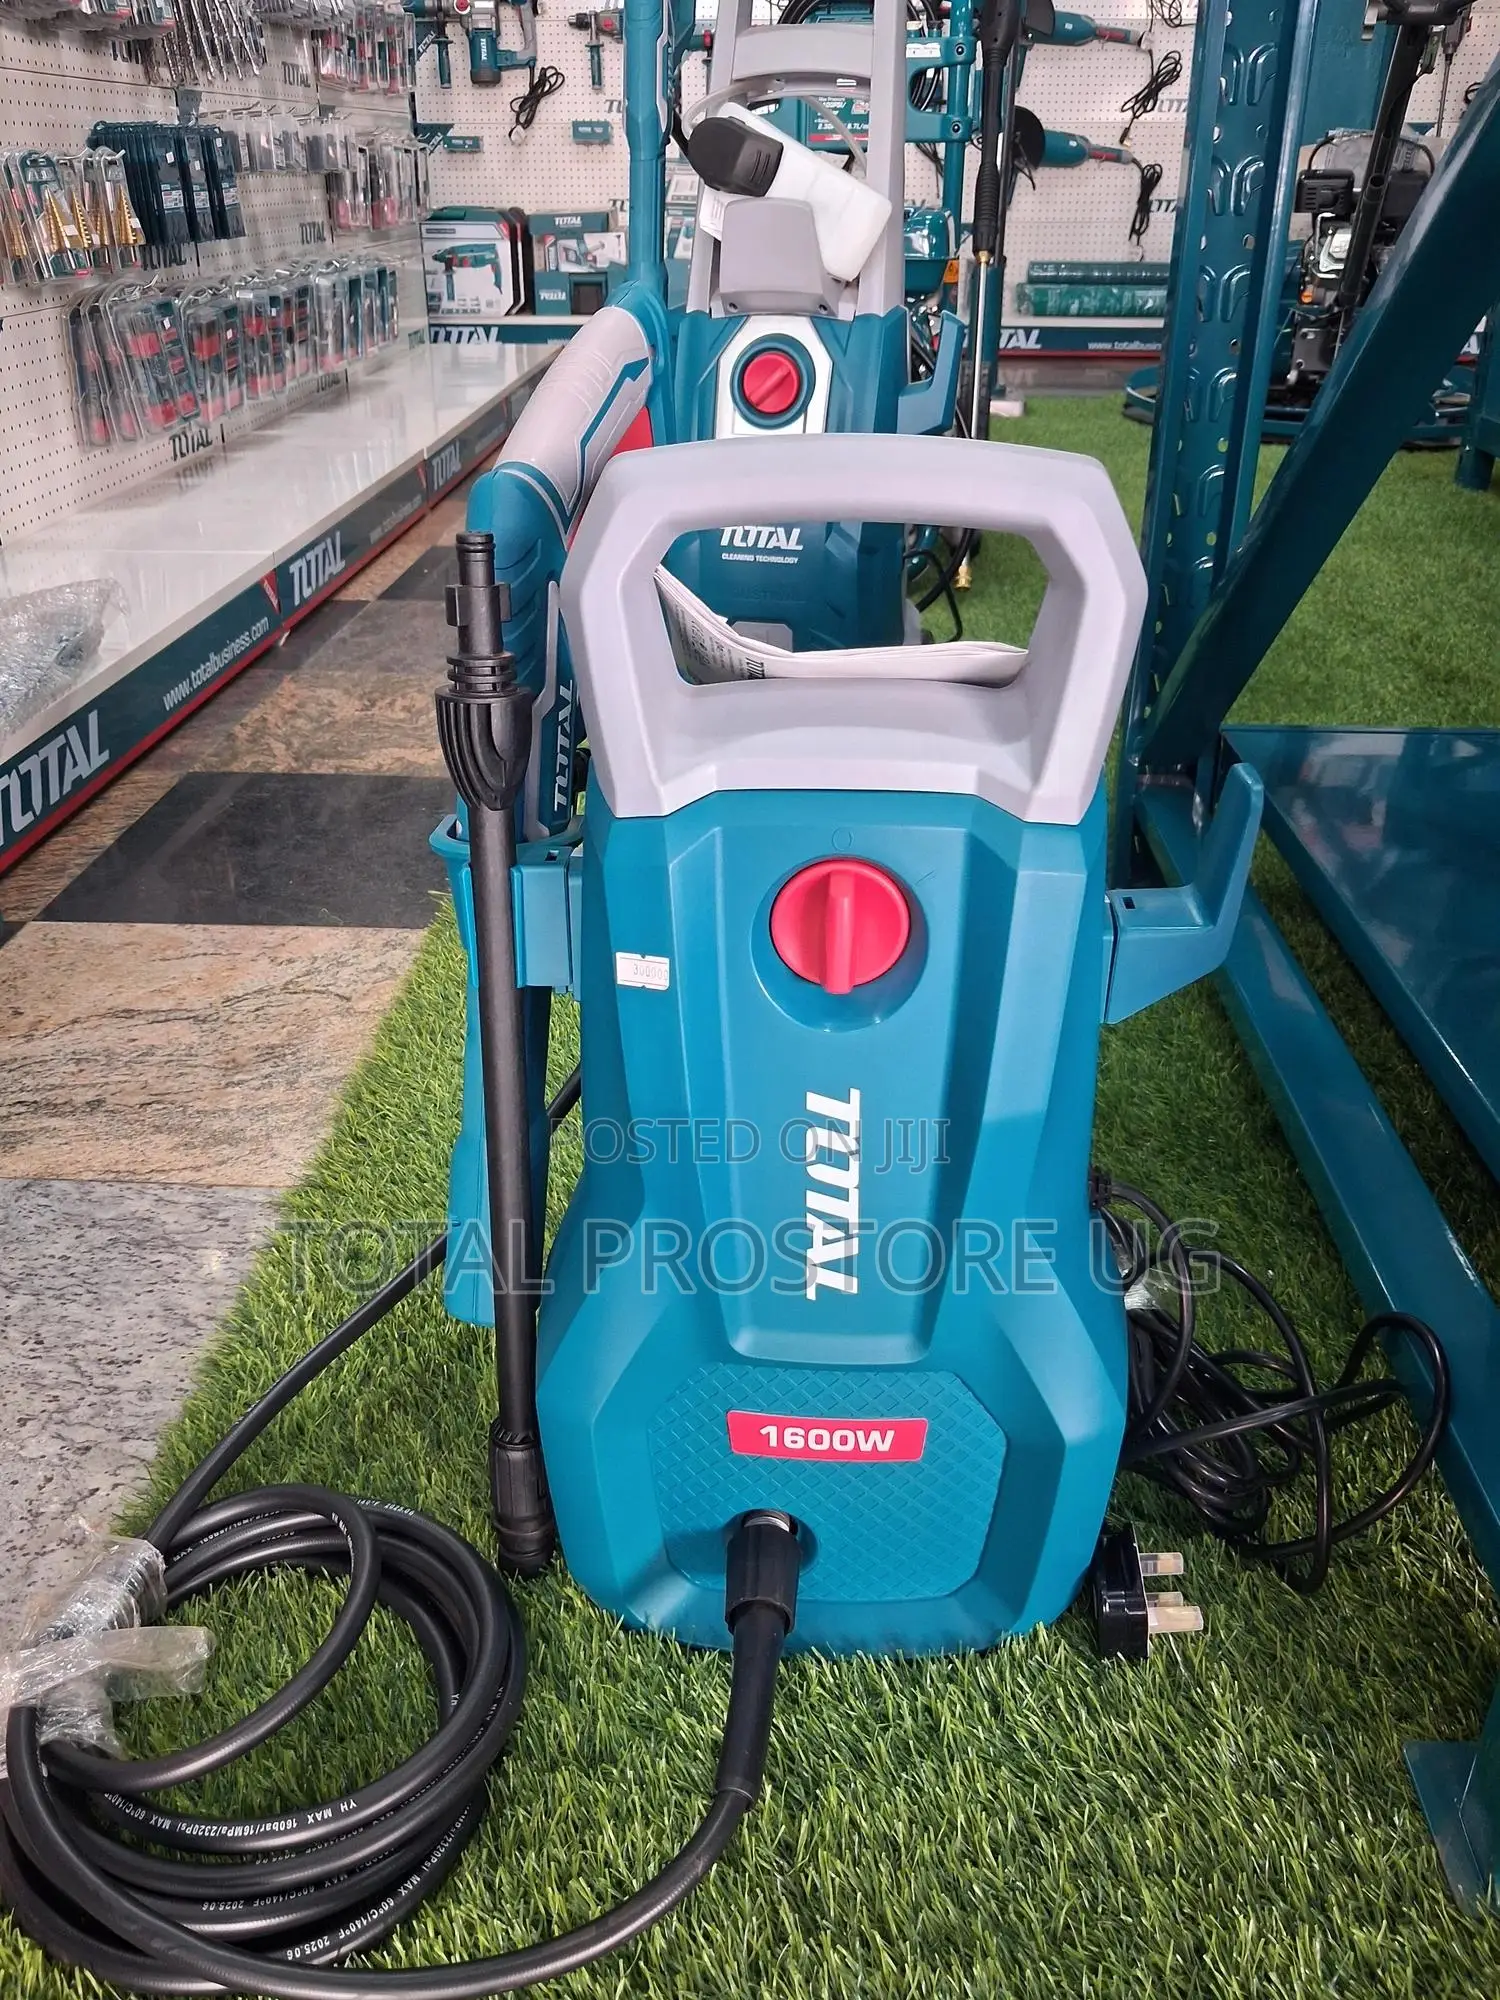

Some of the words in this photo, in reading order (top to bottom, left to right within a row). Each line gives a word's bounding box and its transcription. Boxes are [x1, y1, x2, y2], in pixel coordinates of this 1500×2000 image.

[554, 216, 582, 226] TOTAL
[720, 525, 804, 551] TOTAL
[289, 530, 346, 606] TOTAL
[756, 555, 799, 564] TECHNOLOGY
[163, 617, 270, 711] www.totalbusiness.com
[554, 679, 573, 812] TOTAL
[805, 1087, 860, 1301] TOTAL
[759, 1425, 896, 1452] 1600W
[307, 1808, 333, 1825] MAX
[340, 1799, 358, 1813] YH
[149, 1814, 172, 1830] MAX
[176, 1818, 298, 1837] 160bar/16MPa/2320Psi
[397, 1875, 421, 1897] MAX
[338, 1897, 394, 1940] 60°C/140°F
[286, 1935, 330, 1960] 2025.06
